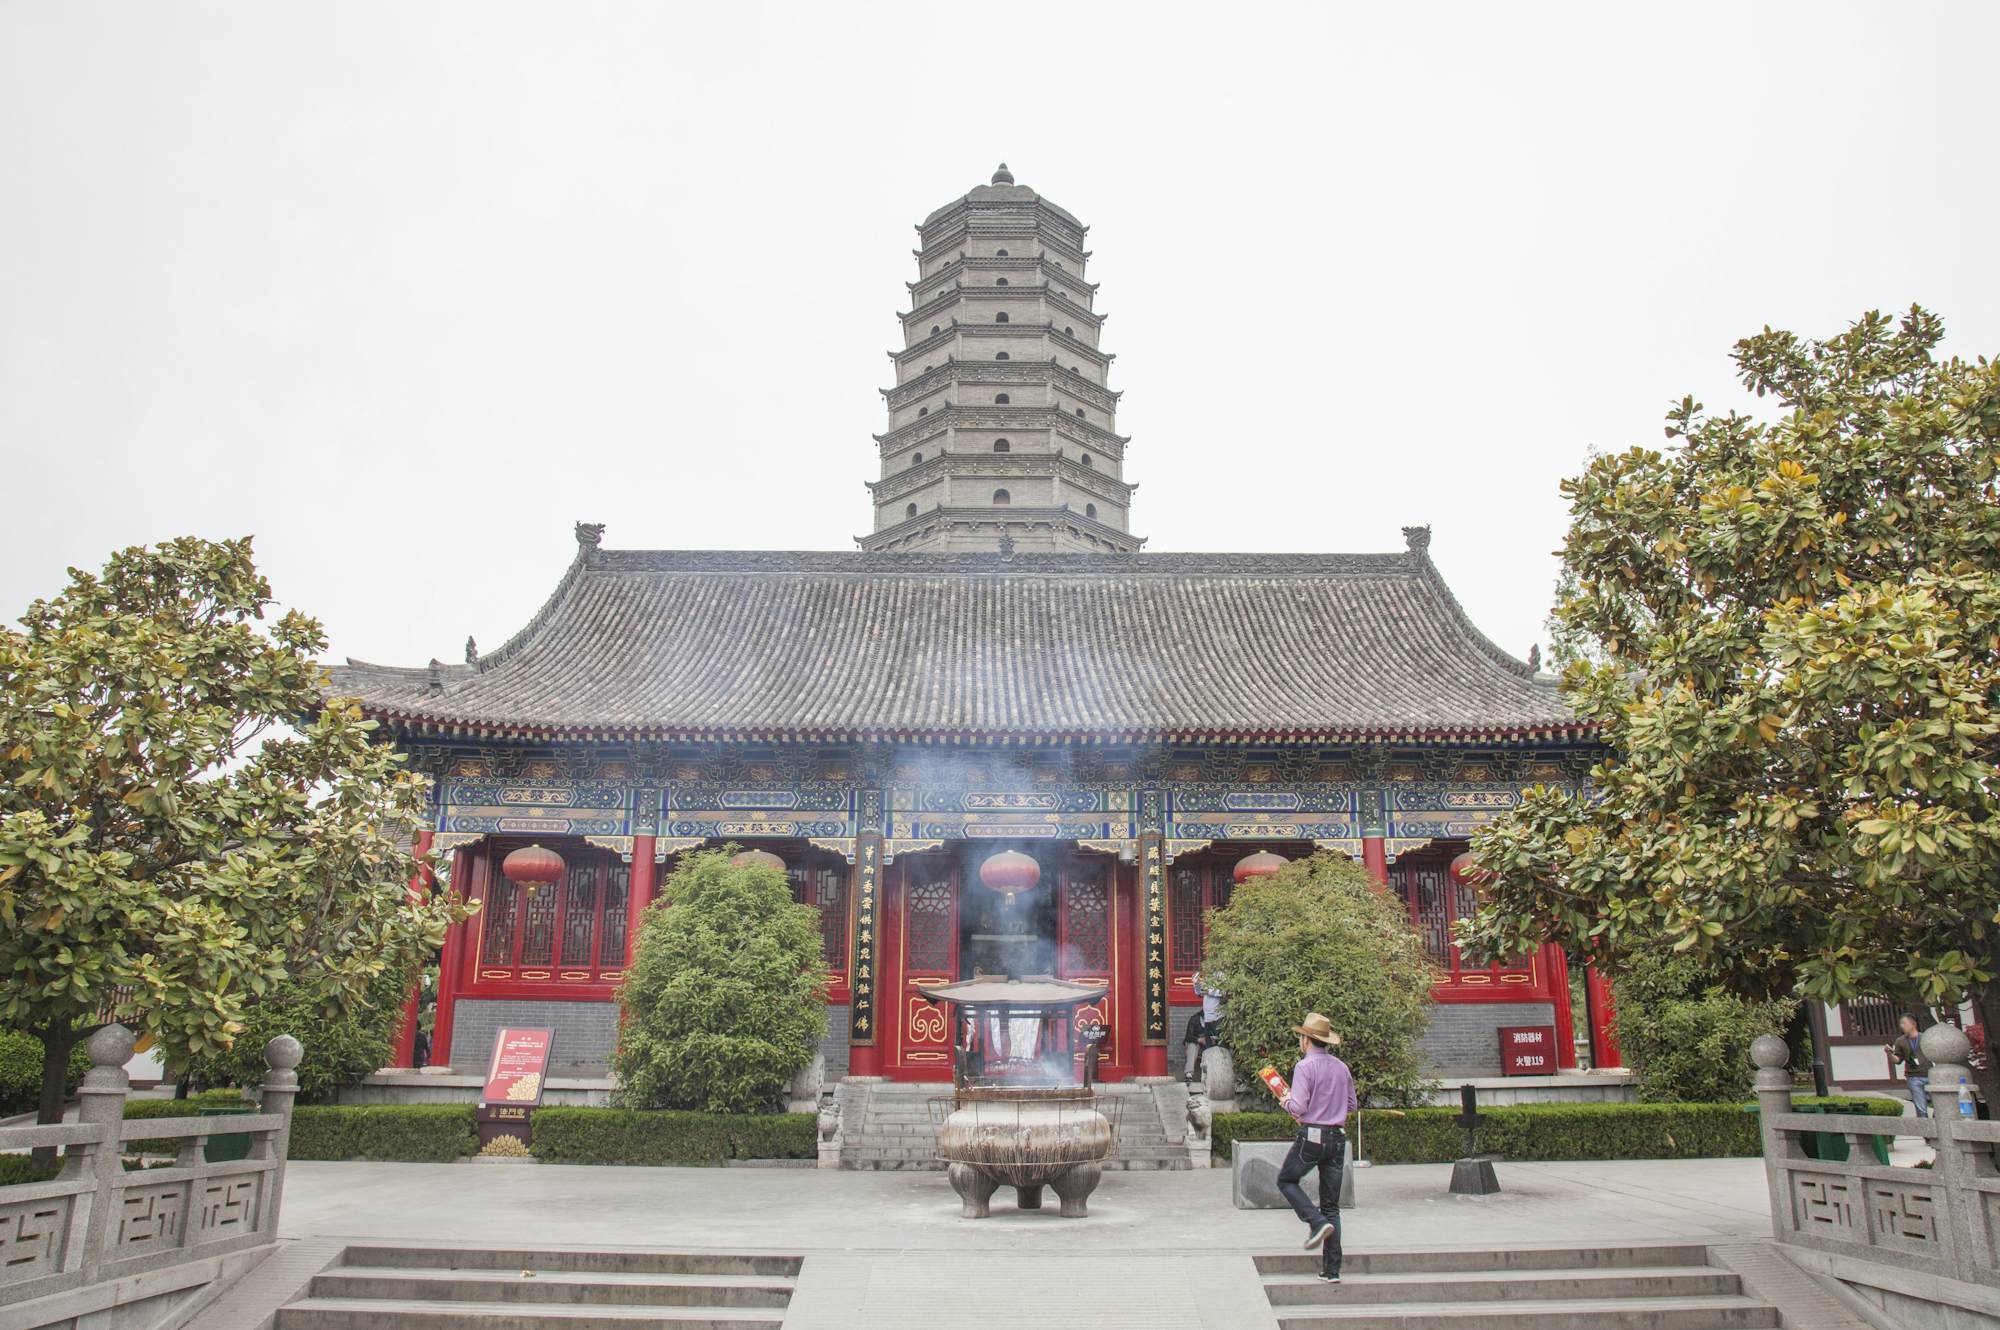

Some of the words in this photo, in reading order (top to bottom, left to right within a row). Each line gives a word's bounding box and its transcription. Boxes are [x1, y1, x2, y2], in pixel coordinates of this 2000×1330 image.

[1512, 1032, 1542, 1043] 消防器材
[1515, 1055, 1544, 1067] 火警119
